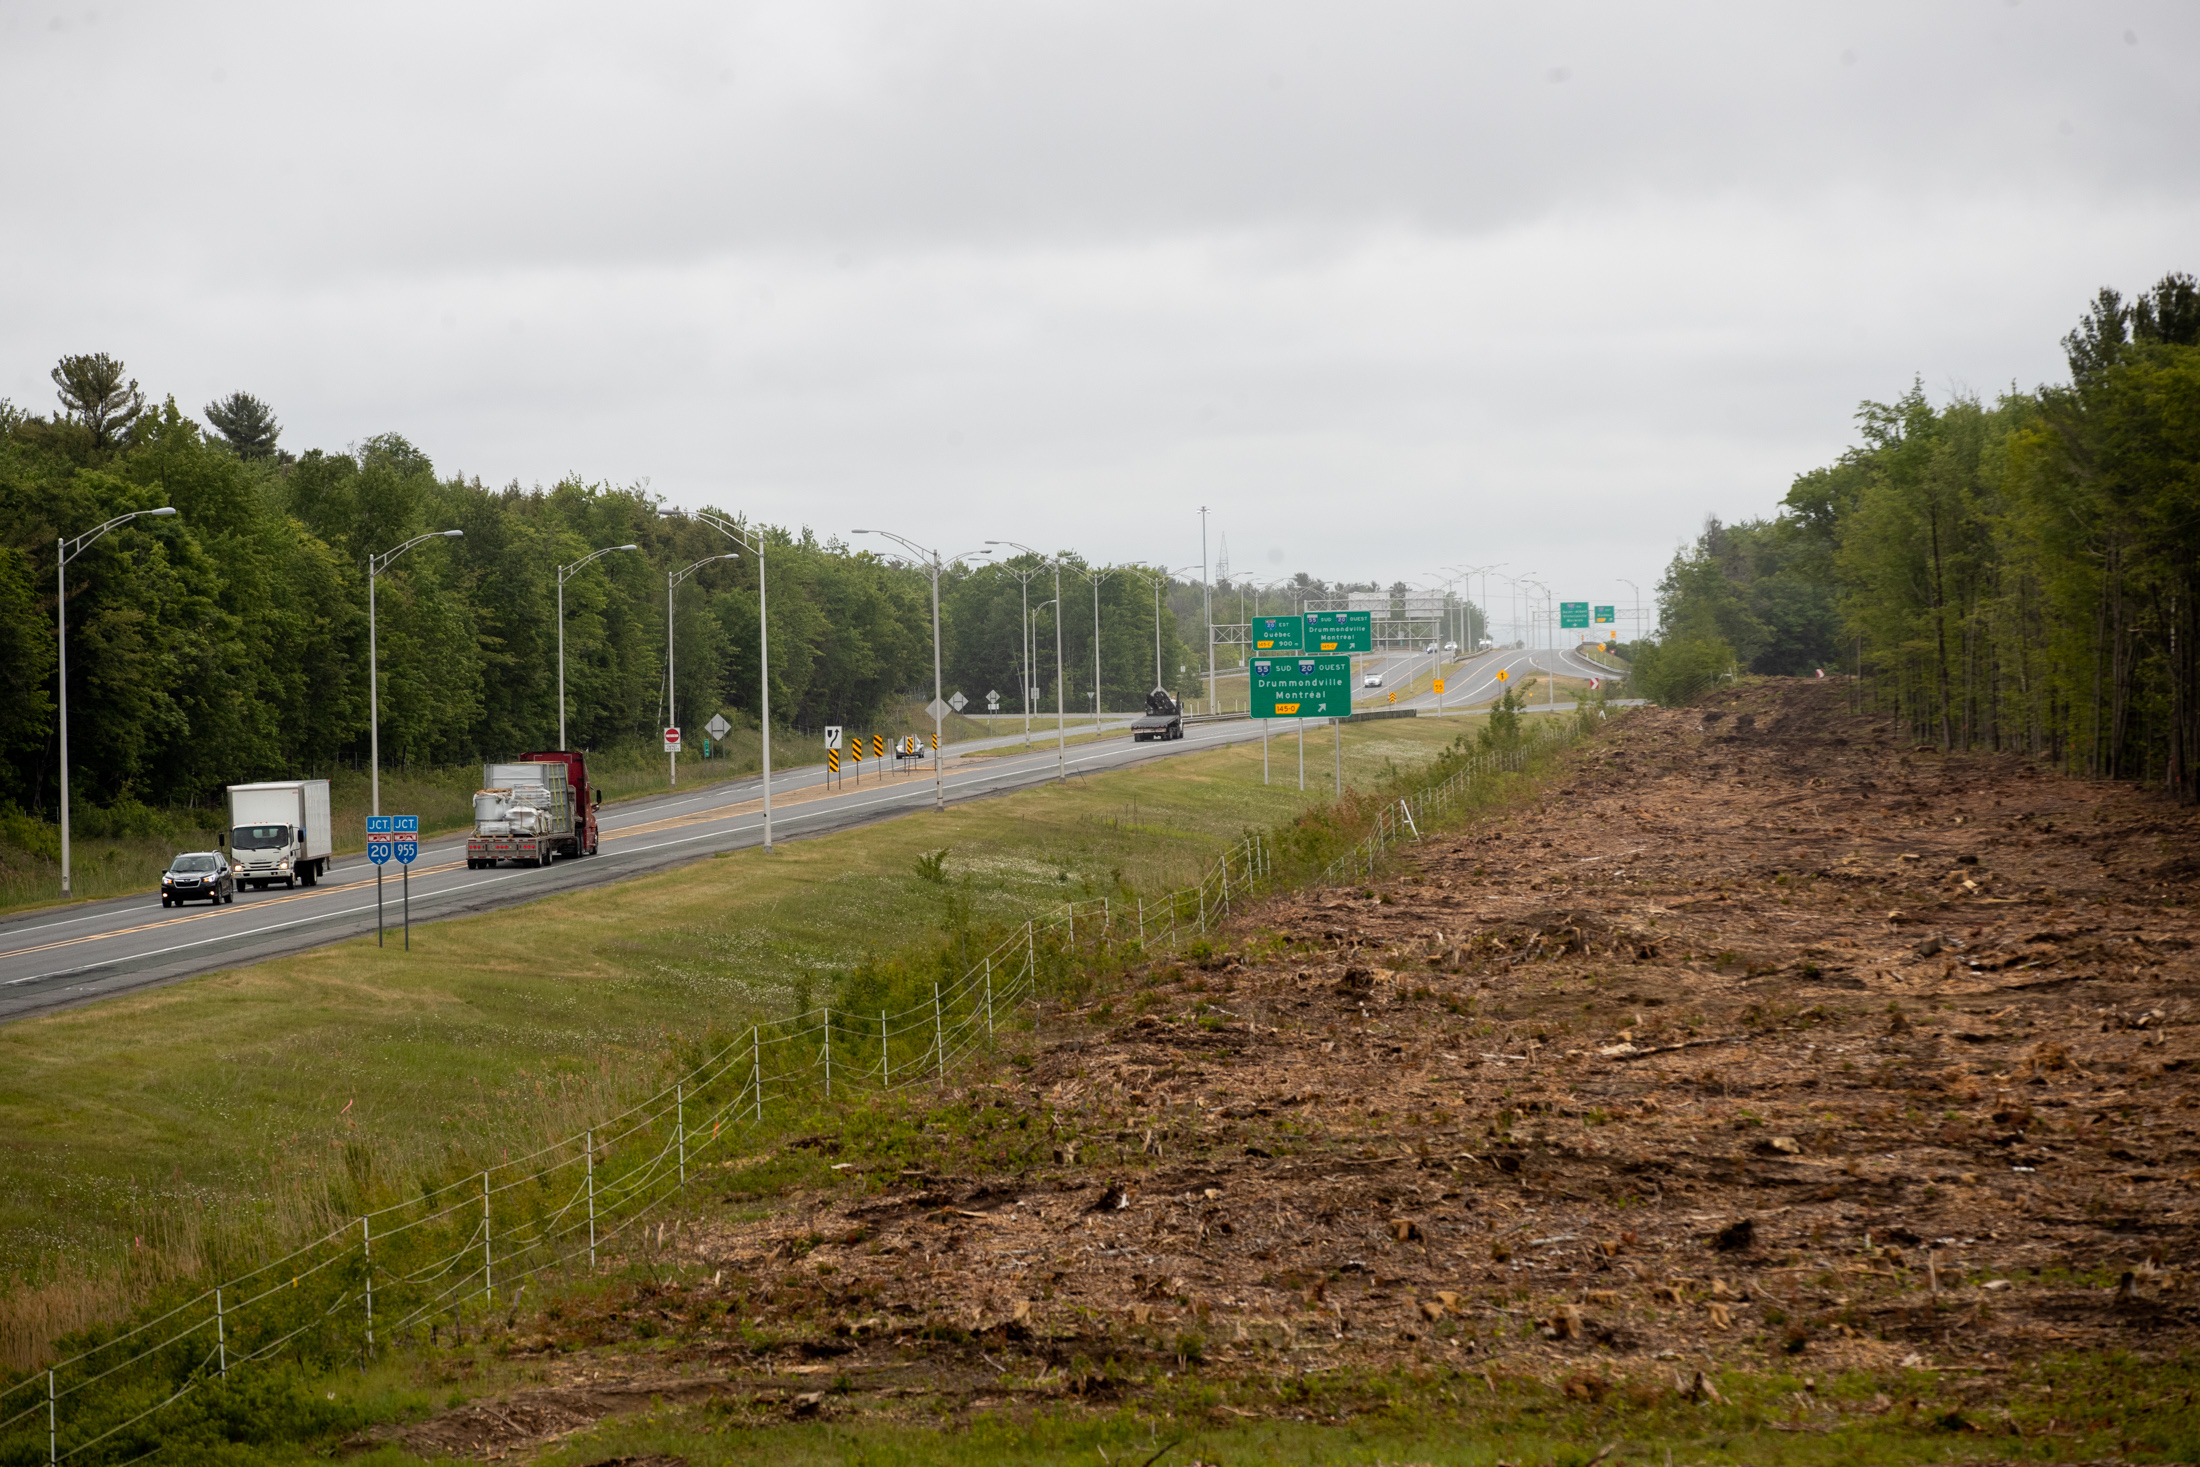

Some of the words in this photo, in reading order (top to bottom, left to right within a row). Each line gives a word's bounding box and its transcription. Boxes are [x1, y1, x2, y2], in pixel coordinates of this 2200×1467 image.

[1258, 678, 1342, 687] Drummondville
[1276, 690, 1326, 699] Montréal
[369, 820, 390, 830] JCT.
[395, 819, 416, 828] JCT.
[370, 844, 388, 857] 20
[398, 844, 414, 856] 955
